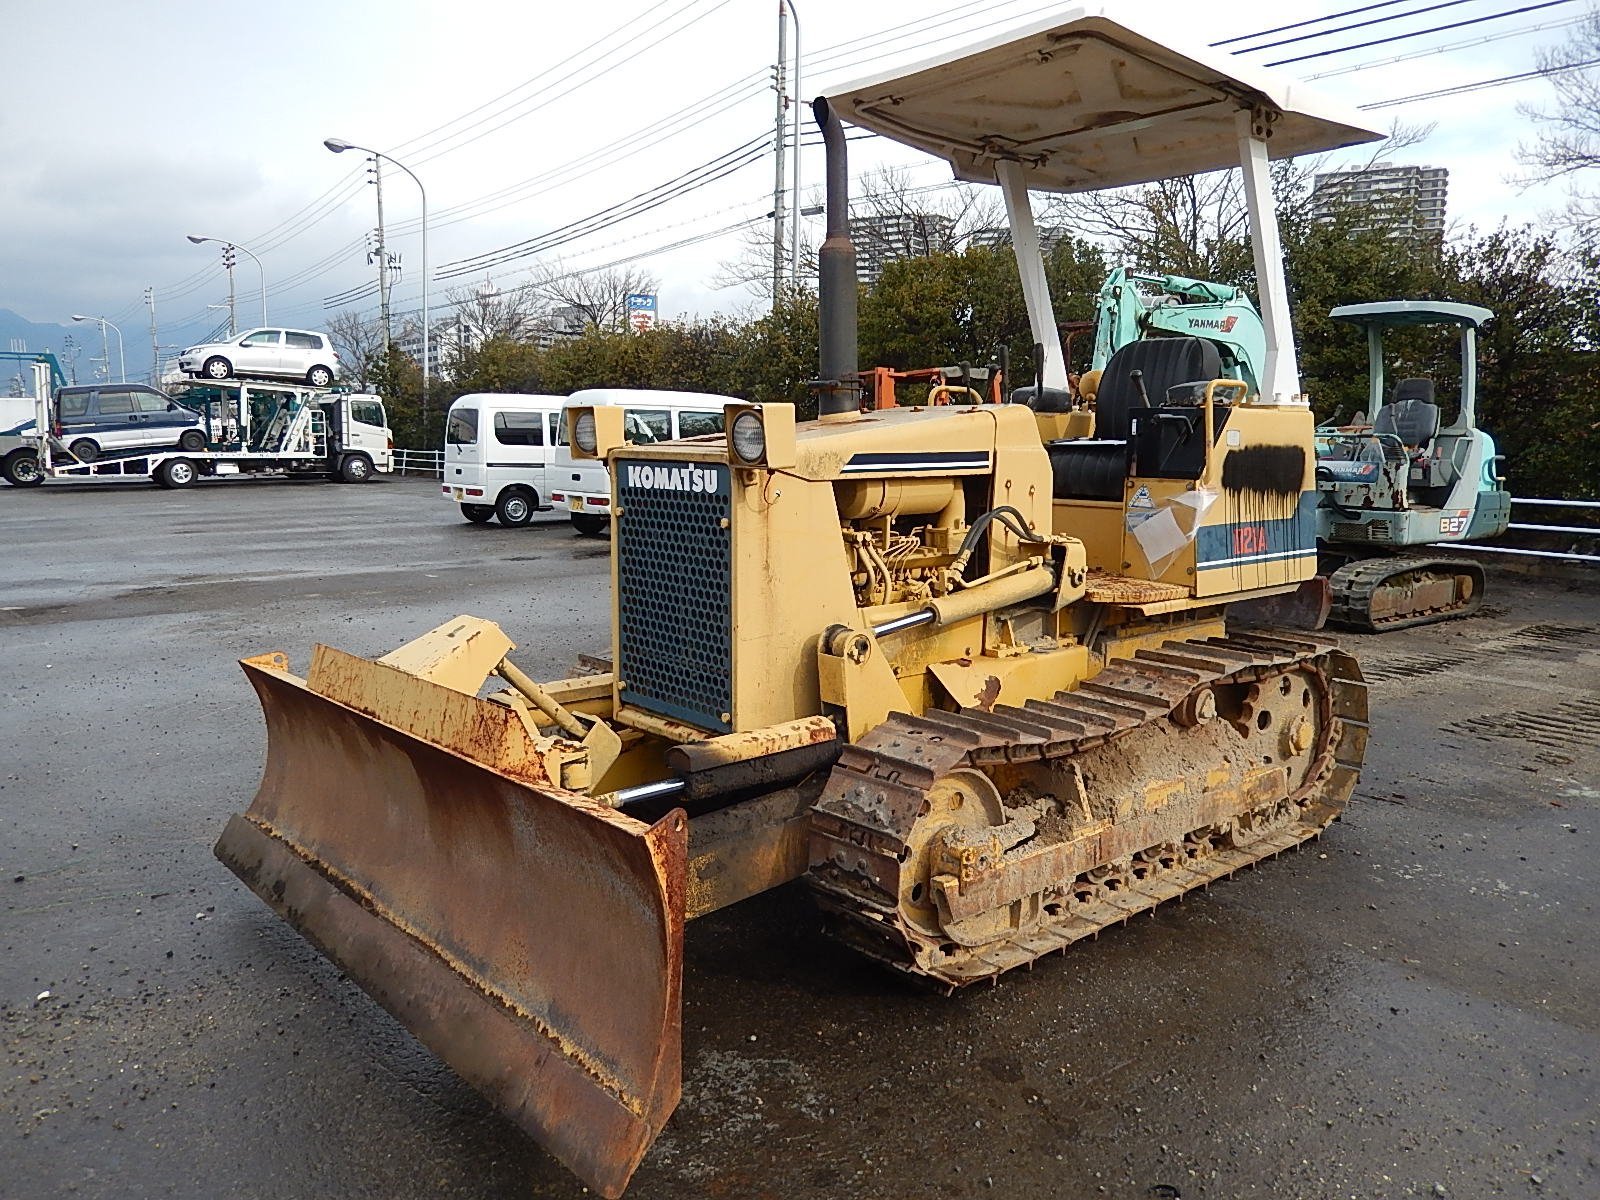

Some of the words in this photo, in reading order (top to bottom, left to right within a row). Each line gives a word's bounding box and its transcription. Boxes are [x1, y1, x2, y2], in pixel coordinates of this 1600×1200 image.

[1188, 317, 1226, 330] YANMAR
[627, 462, 718, 494] KOMATSU
[1440, 516, 1467, 533] B27
